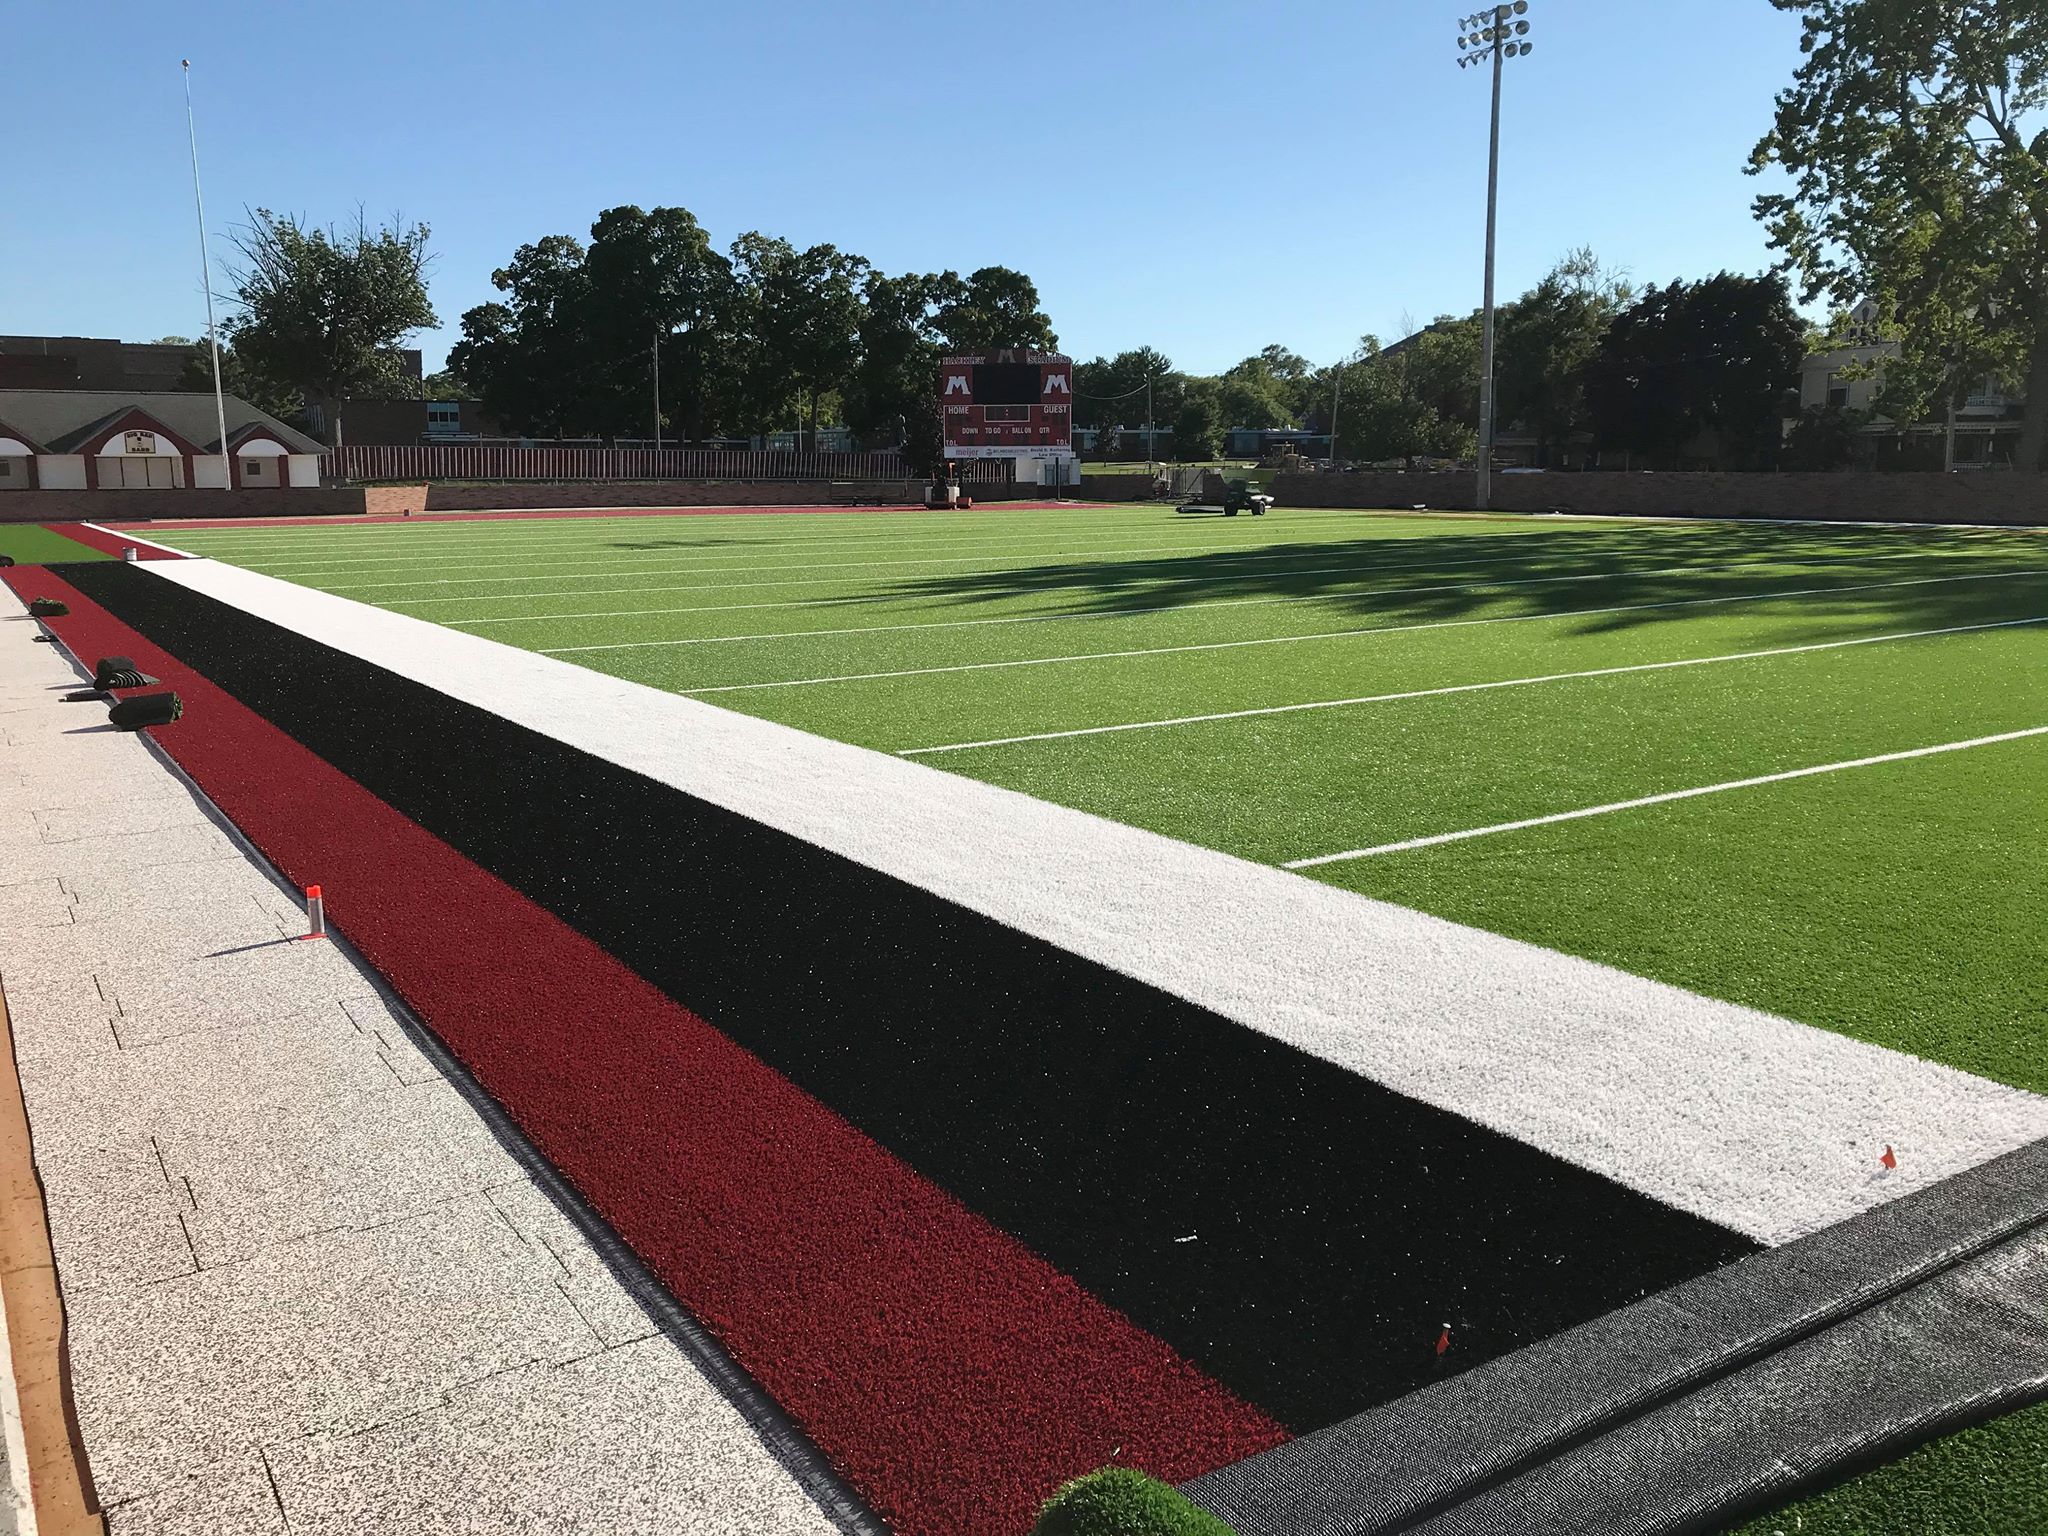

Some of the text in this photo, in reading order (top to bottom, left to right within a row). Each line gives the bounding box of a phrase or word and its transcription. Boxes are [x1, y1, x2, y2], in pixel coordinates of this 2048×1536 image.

[998, 349, 1016, 364] M
[944, 375, 971, 395] M
[1043, 374, 1070, 394] M
[948, 407, 969, 415] HOME
[1043, 405, 1067, 414] GUEST
[962, 427, 979, 435] DOWN
[955, 447, 979, 456] meijer
